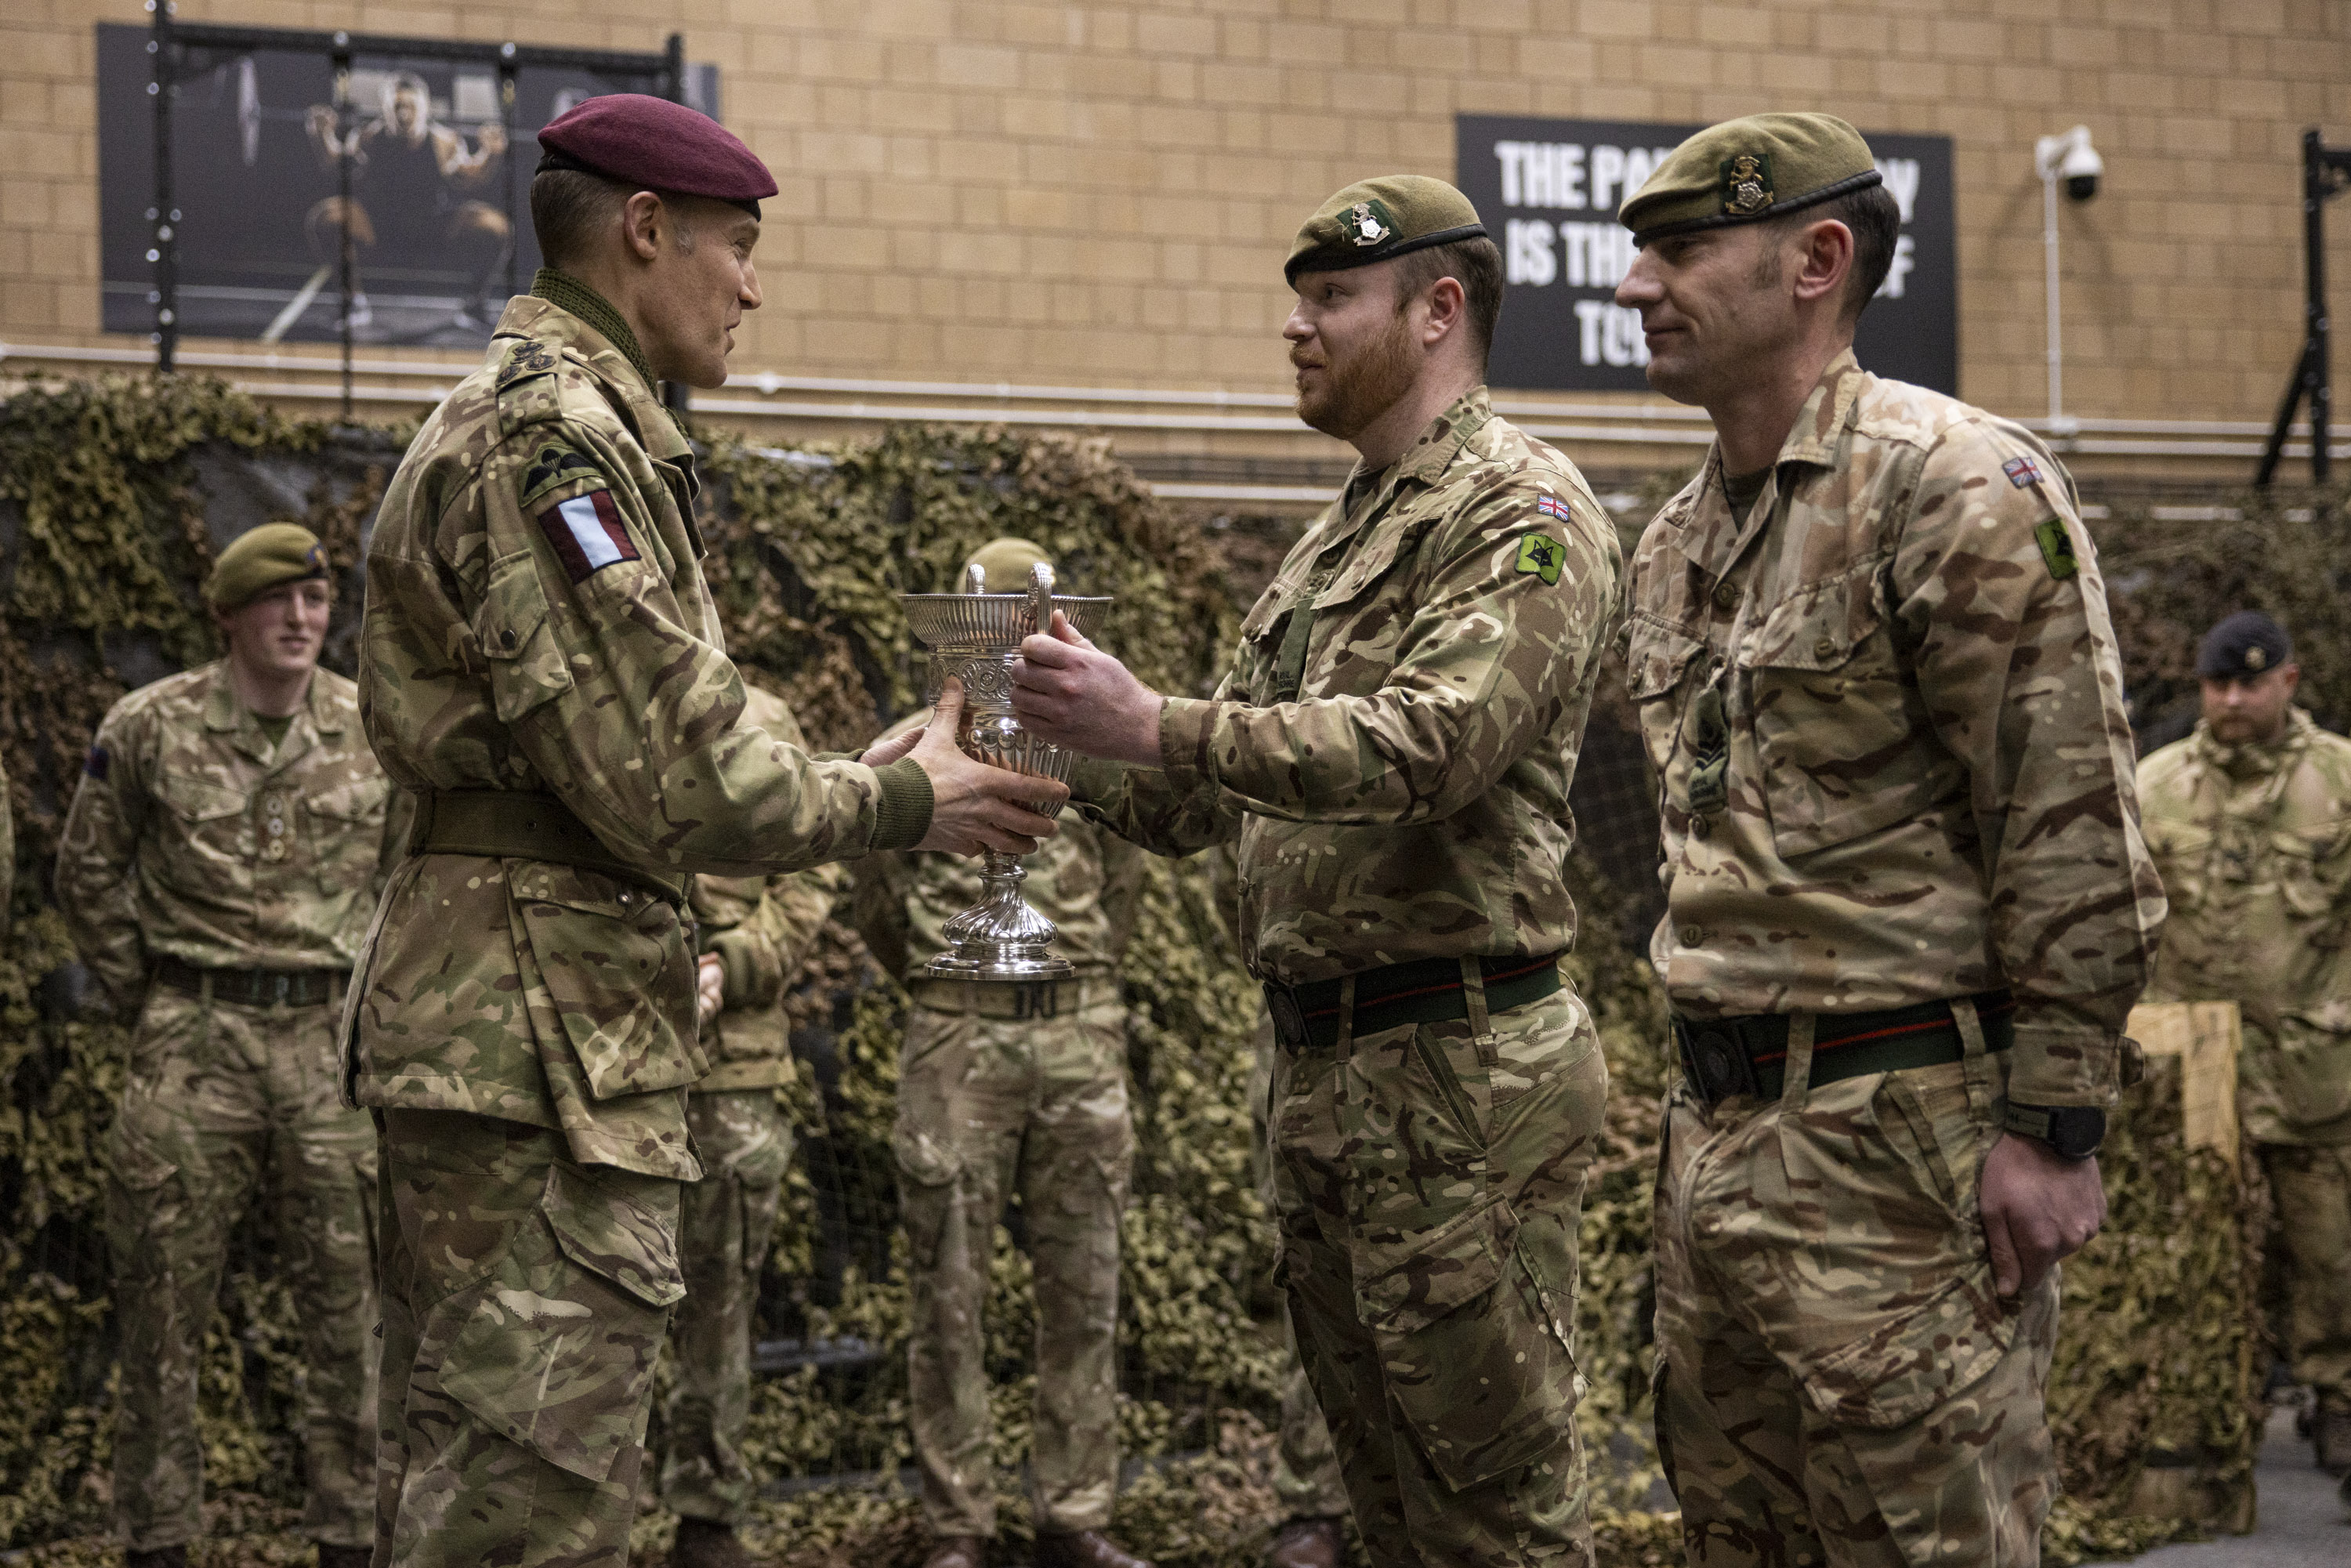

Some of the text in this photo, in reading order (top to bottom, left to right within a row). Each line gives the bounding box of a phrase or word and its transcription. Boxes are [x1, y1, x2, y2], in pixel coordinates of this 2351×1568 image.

[1495, 141, 1586, 208] THE
[1592, 145, 1675, 211] PA
[1505, 220, 1556, 285] IS
